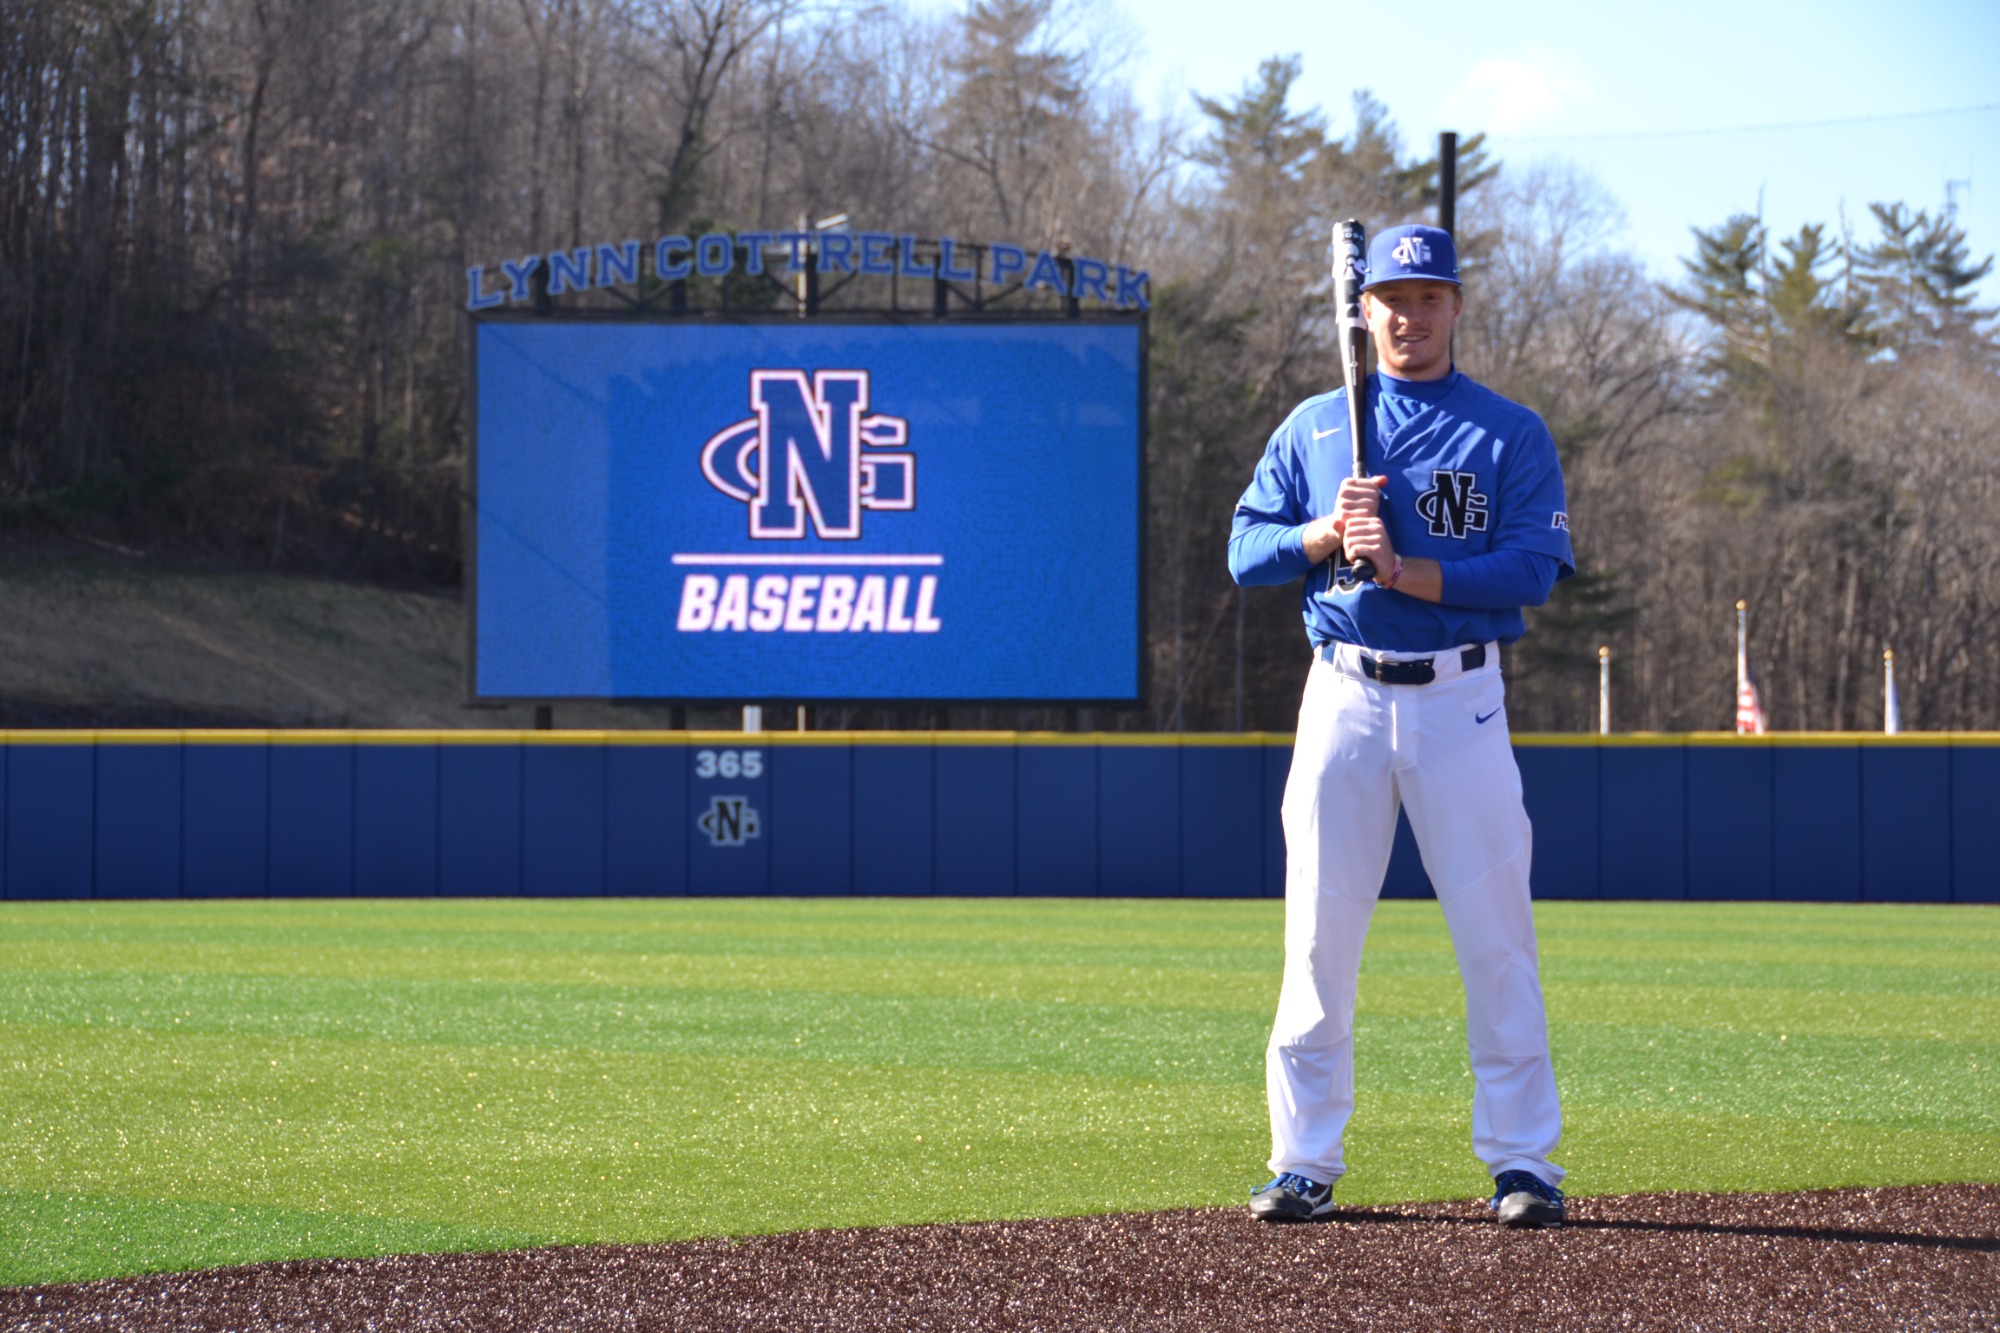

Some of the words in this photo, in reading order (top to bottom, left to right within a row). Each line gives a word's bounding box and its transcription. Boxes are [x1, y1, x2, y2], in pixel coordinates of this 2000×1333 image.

[466, 240, 641, 311] LYNN
[655, 231, 976, 282] COTTRELL
[989, 241, 1152, 312] PARK
[676, 573, 942, 633] BASEBALL
[696, 749, 763, 778] 365
